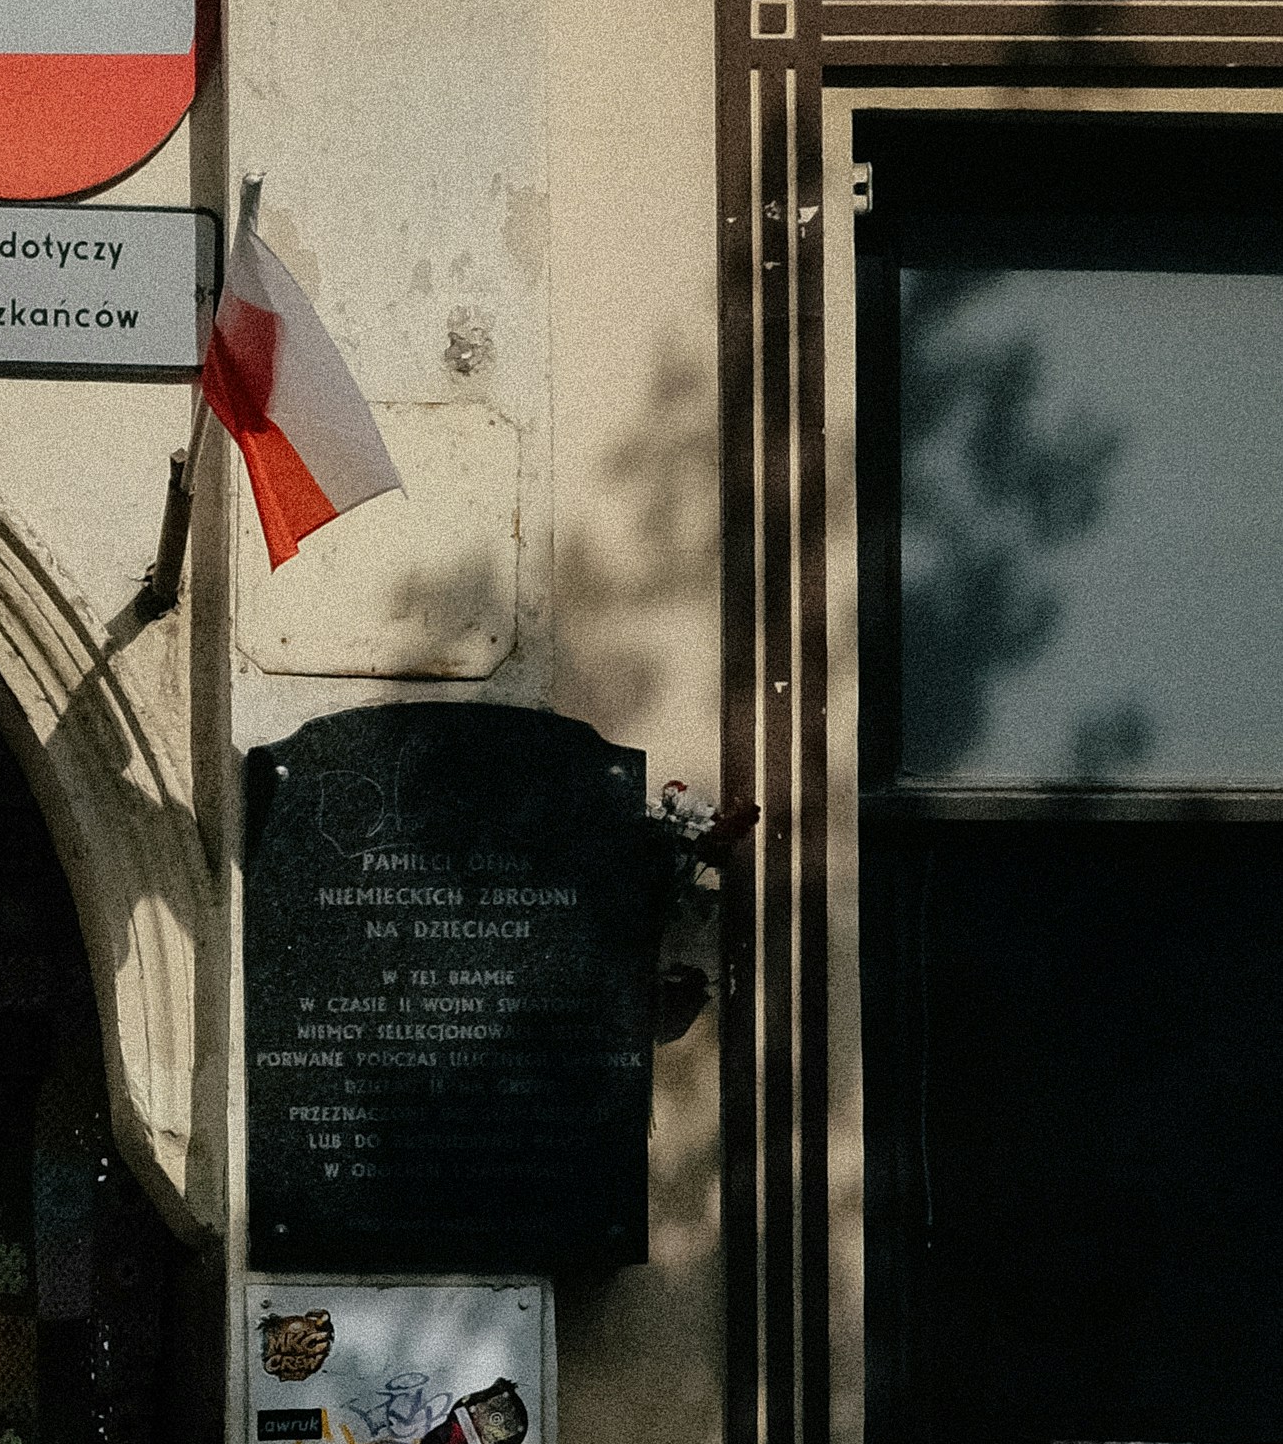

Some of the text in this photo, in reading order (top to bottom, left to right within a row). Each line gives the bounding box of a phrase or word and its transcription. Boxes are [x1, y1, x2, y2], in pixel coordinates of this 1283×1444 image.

[317, 886, 463, 908] NIEMIECKICH
[365, 919, 532, 941] NA DZIECIACH
